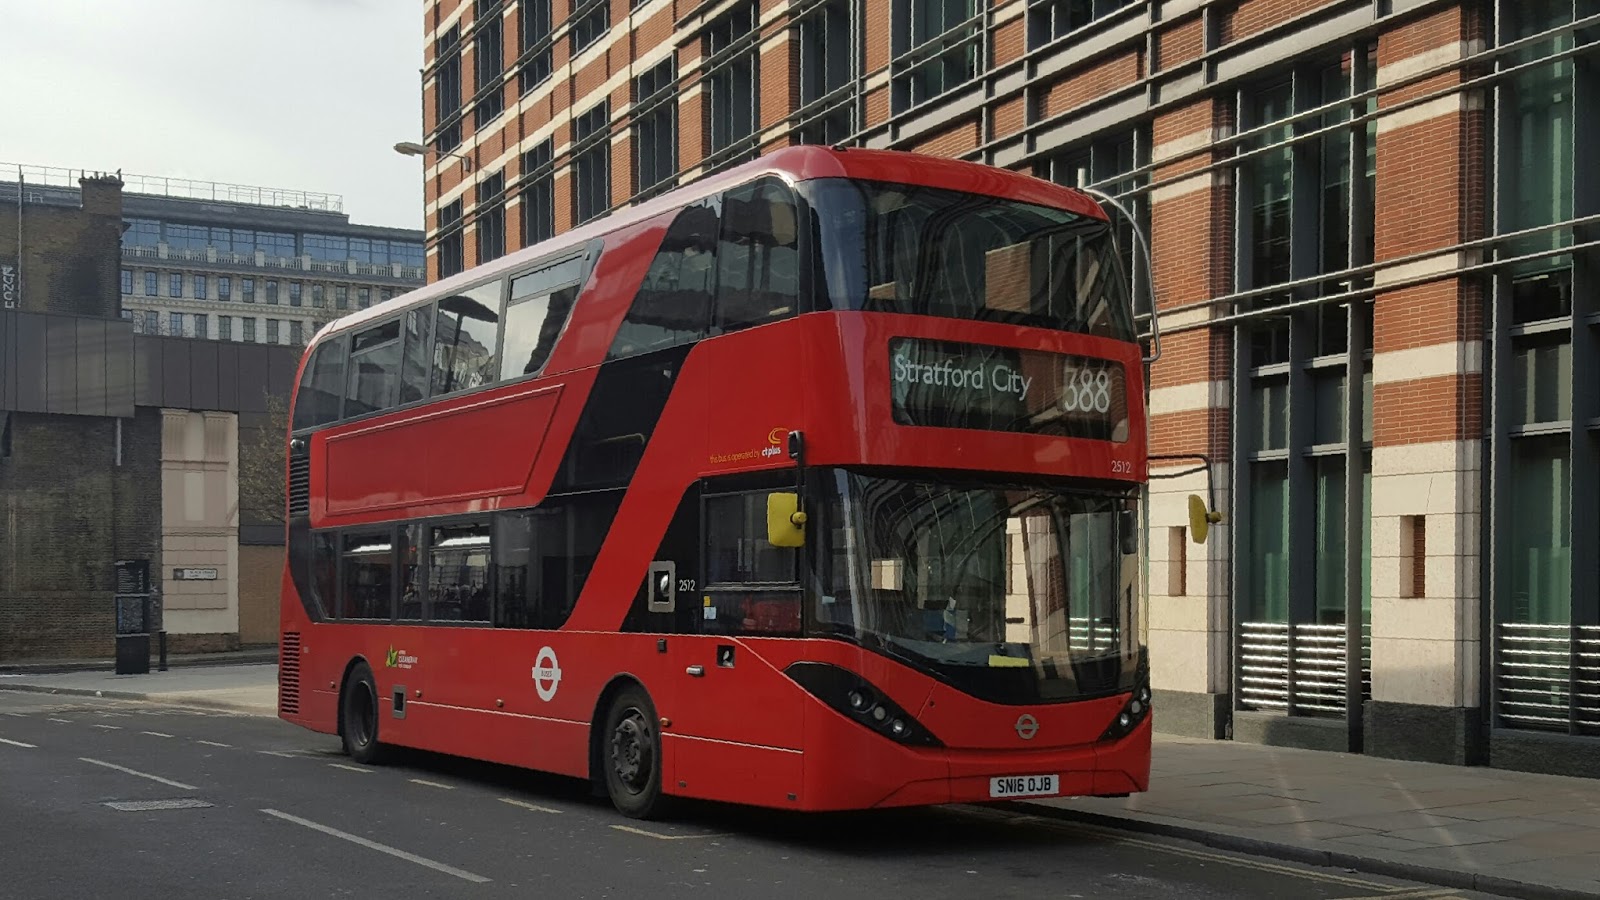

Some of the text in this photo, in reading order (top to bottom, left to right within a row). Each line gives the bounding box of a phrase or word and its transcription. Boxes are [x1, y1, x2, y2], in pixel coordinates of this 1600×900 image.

[895, 354, 1033, 401] Stratford City
[1063, 367, 1110, 413] 388
[1111, 460, 1131, 474] 2512
[679, 579, 695, 592] 2512
[997, 777, 1052, 794] SN16 OJB
